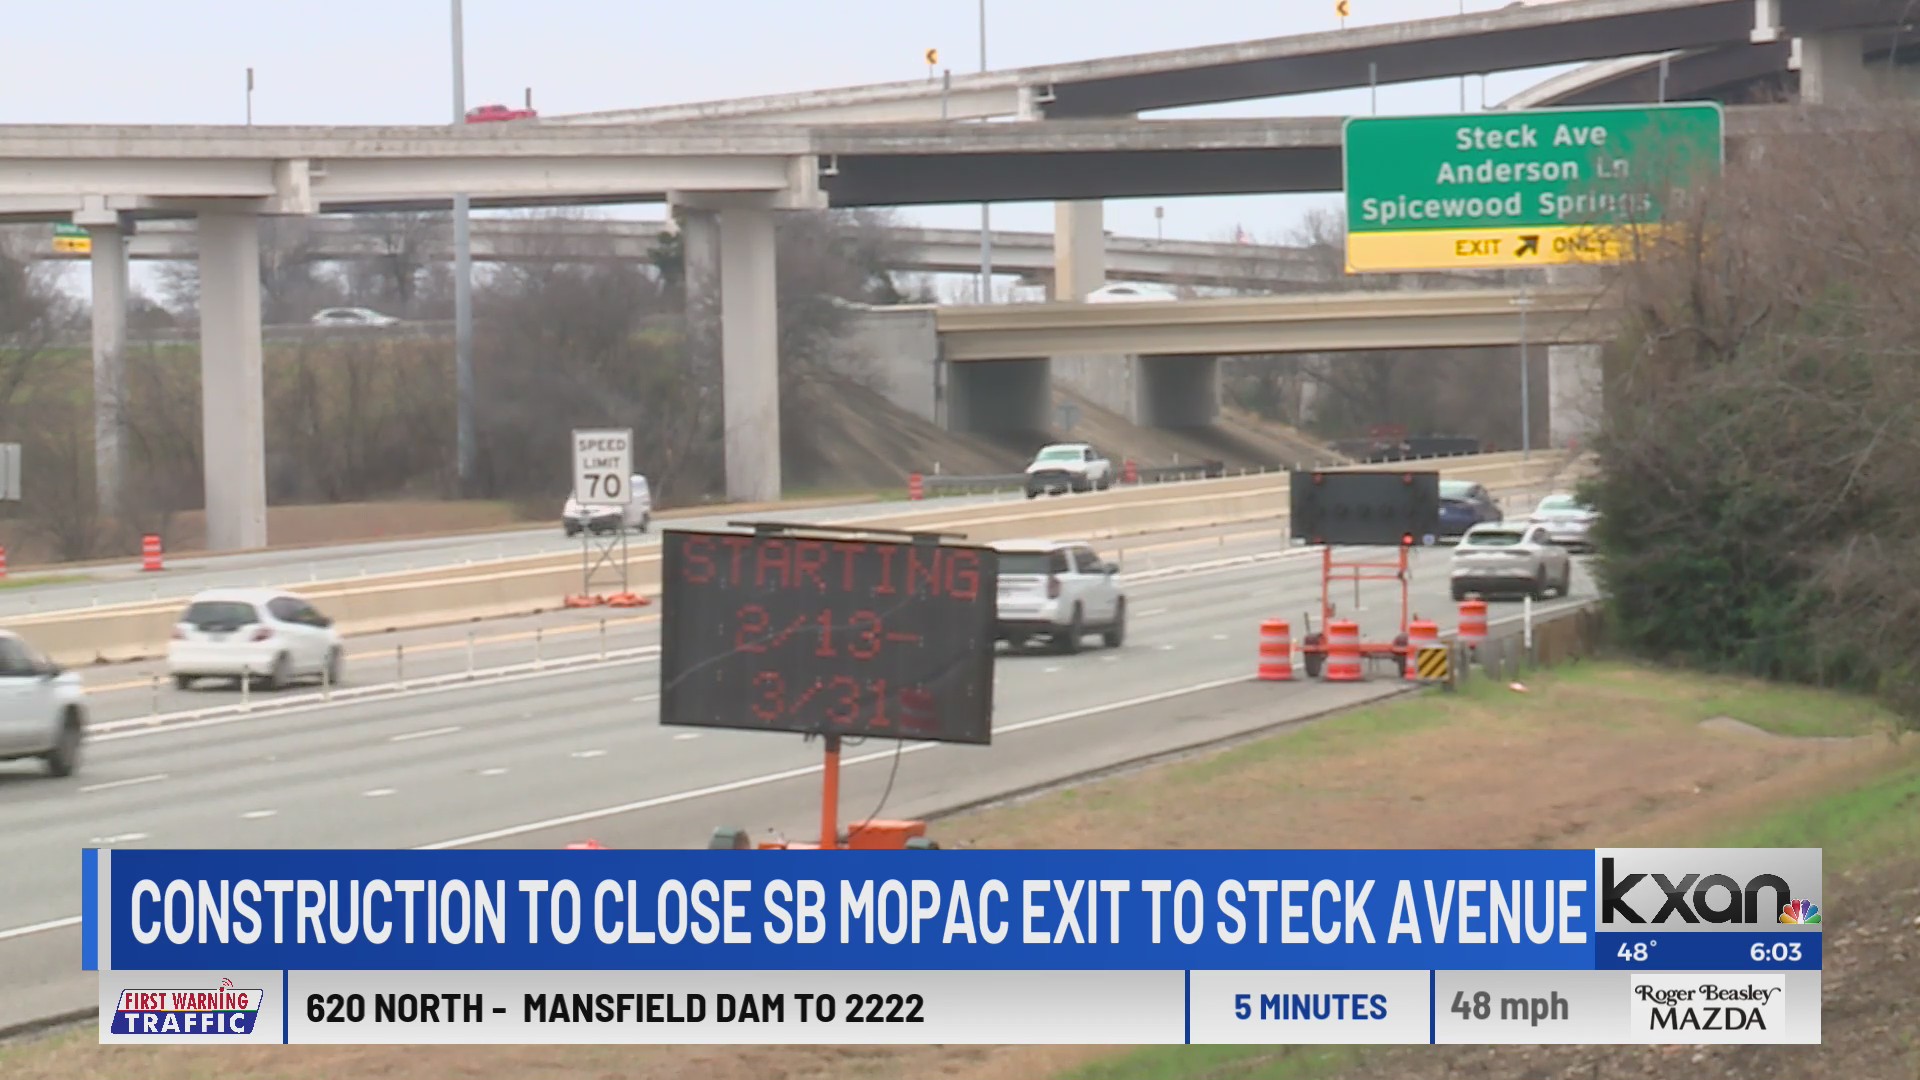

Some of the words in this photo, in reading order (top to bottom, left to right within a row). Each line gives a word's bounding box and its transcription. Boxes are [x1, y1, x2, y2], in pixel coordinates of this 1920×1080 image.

[1456, 124, 1538, 151] Steck
[1552, 124, 1608, 147] Ave
[1437, 158, 1579, 185] Anderson
[1596, 156, 1630, 179] Ln
[1362, 193, 1522, 226] Spicewood
[1455, 239, 1501, 256] EXIT
[579, 439, 626, 452] SPEED
[583, 457, 620, 469] LIMIT
[583, 473, 621, 498] 70
[681, 535, 980, 601] STARTING
[735, 605, 919, 661] 2/13-
